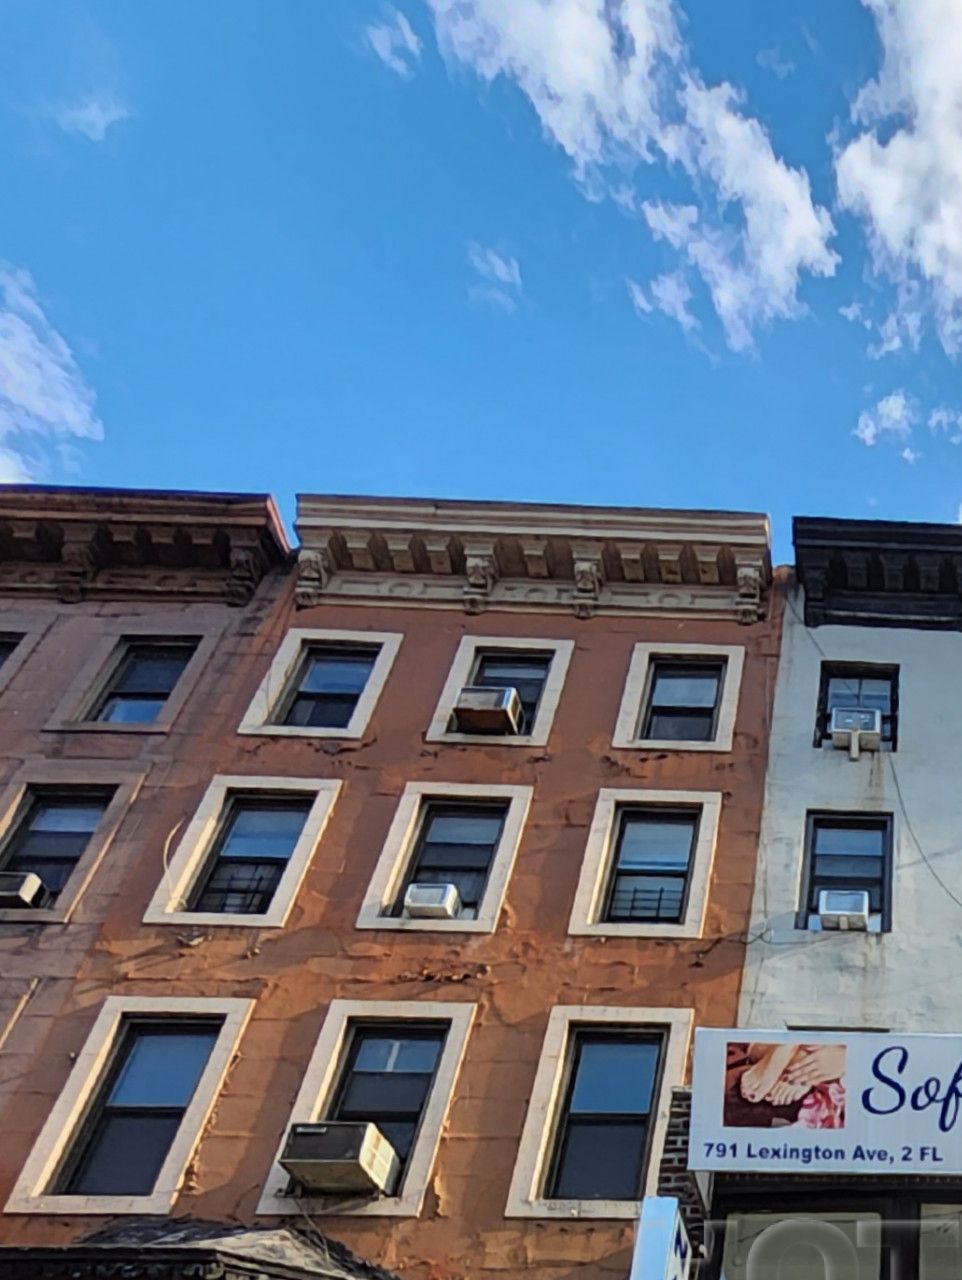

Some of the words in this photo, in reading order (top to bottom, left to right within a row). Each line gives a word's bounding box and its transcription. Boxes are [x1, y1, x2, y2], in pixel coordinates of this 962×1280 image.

[703, 1142, 738, 1160] 791
[746, 1142, 845, 1165] Lexington
[851, 1145, 895, 1163] Ave,
[901, 1145, 915, 1161] 2
[920, 1145, 943, 1162] FL
